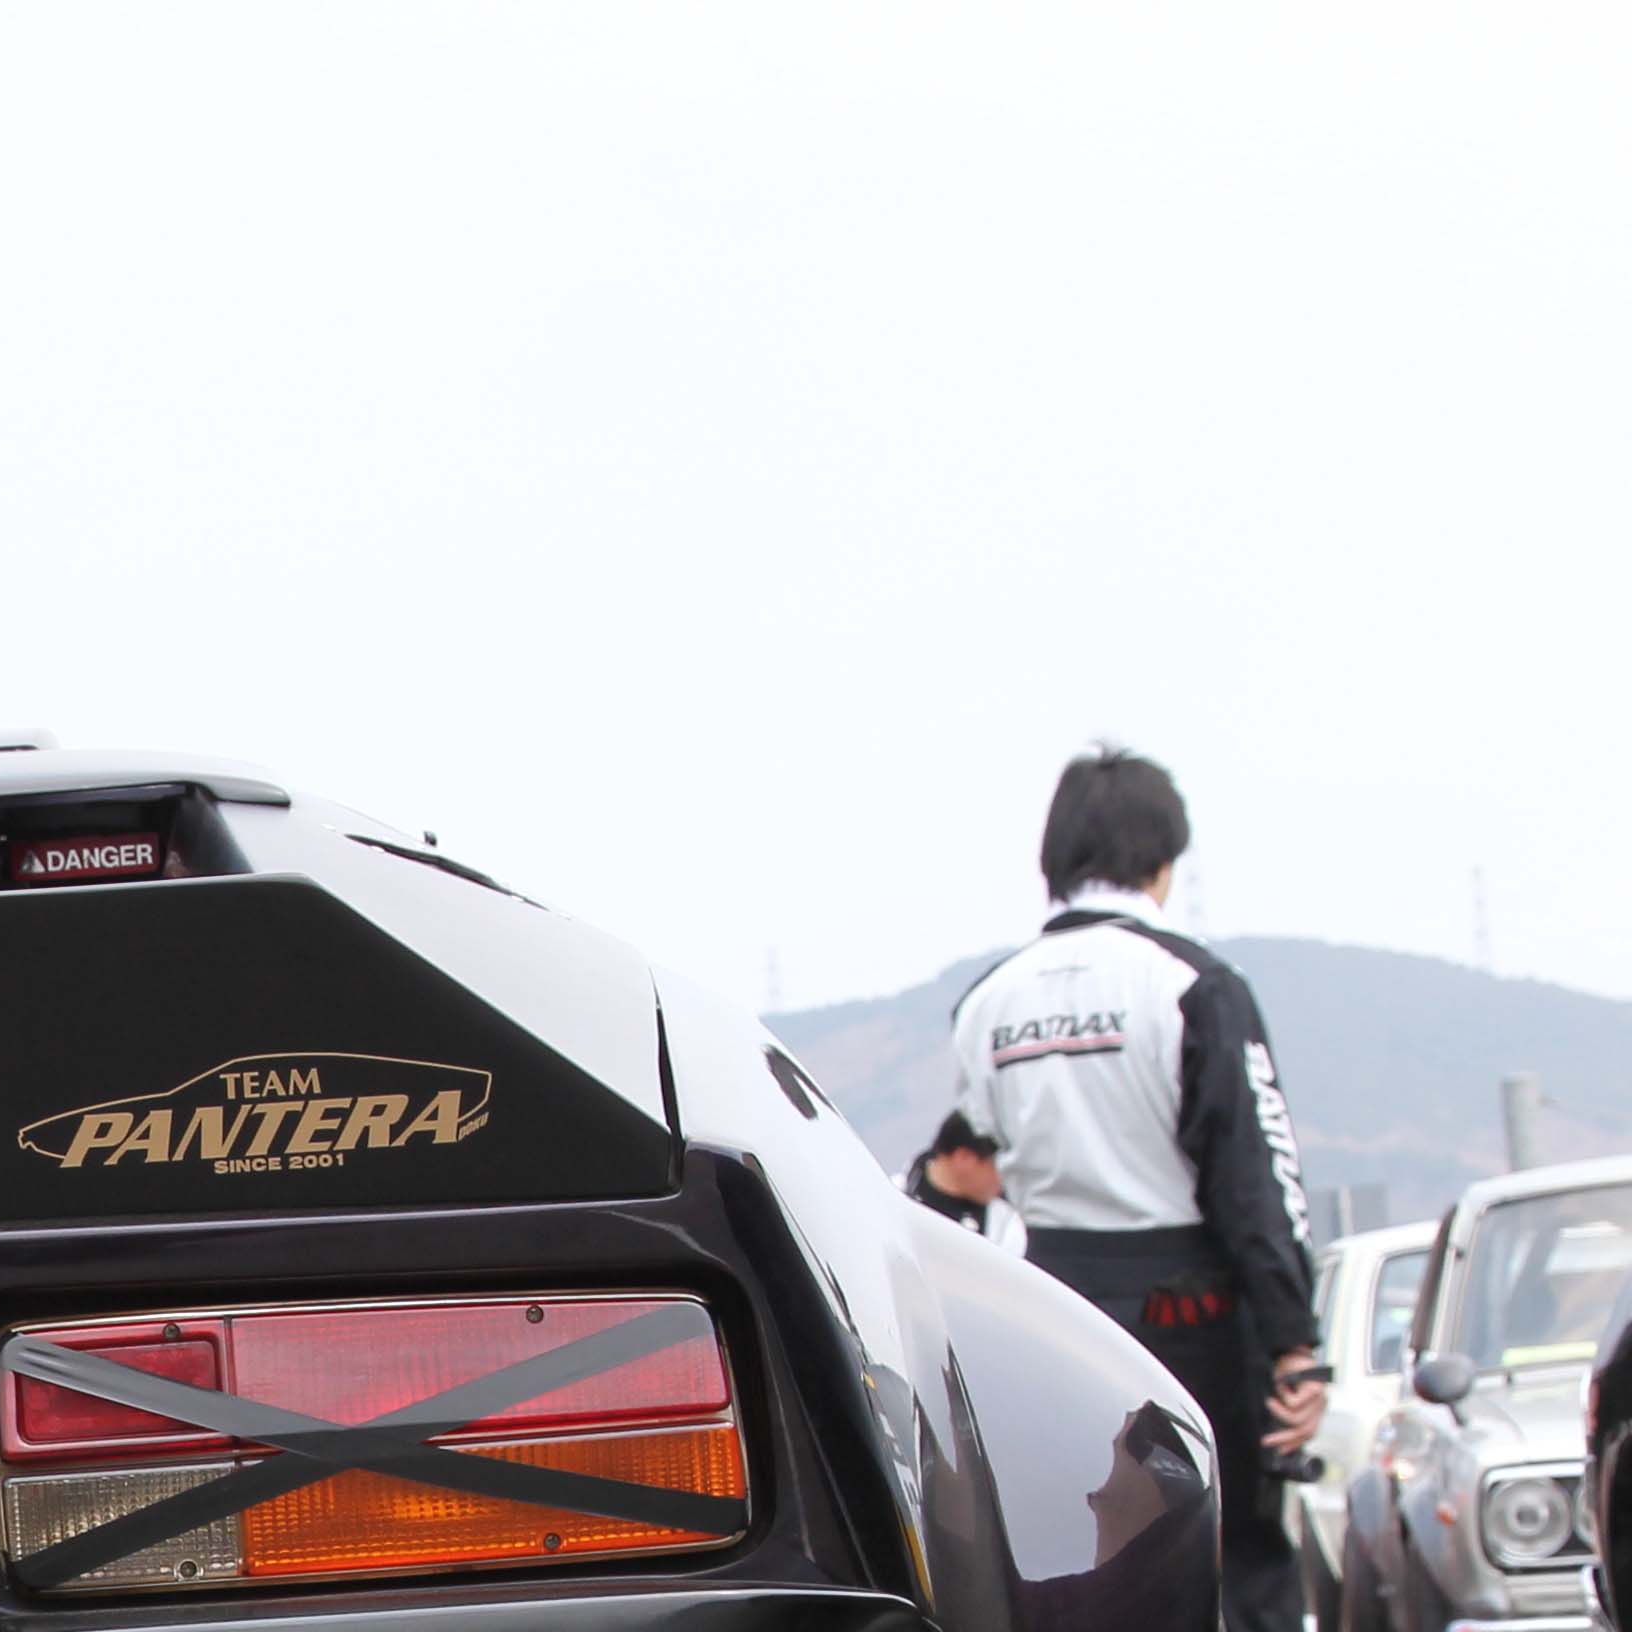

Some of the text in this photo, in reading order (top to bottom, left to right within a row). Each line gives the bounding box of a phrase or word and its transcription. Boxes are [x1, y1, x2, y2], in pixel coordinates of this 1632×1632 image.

[45, 843, 154, 873] DANGER
[219, 1067, 322, 1100] TEAM
[59, 1089, 463, 1169] PANTERA
[213, 1153, 345, 1175] SINCE 2001
